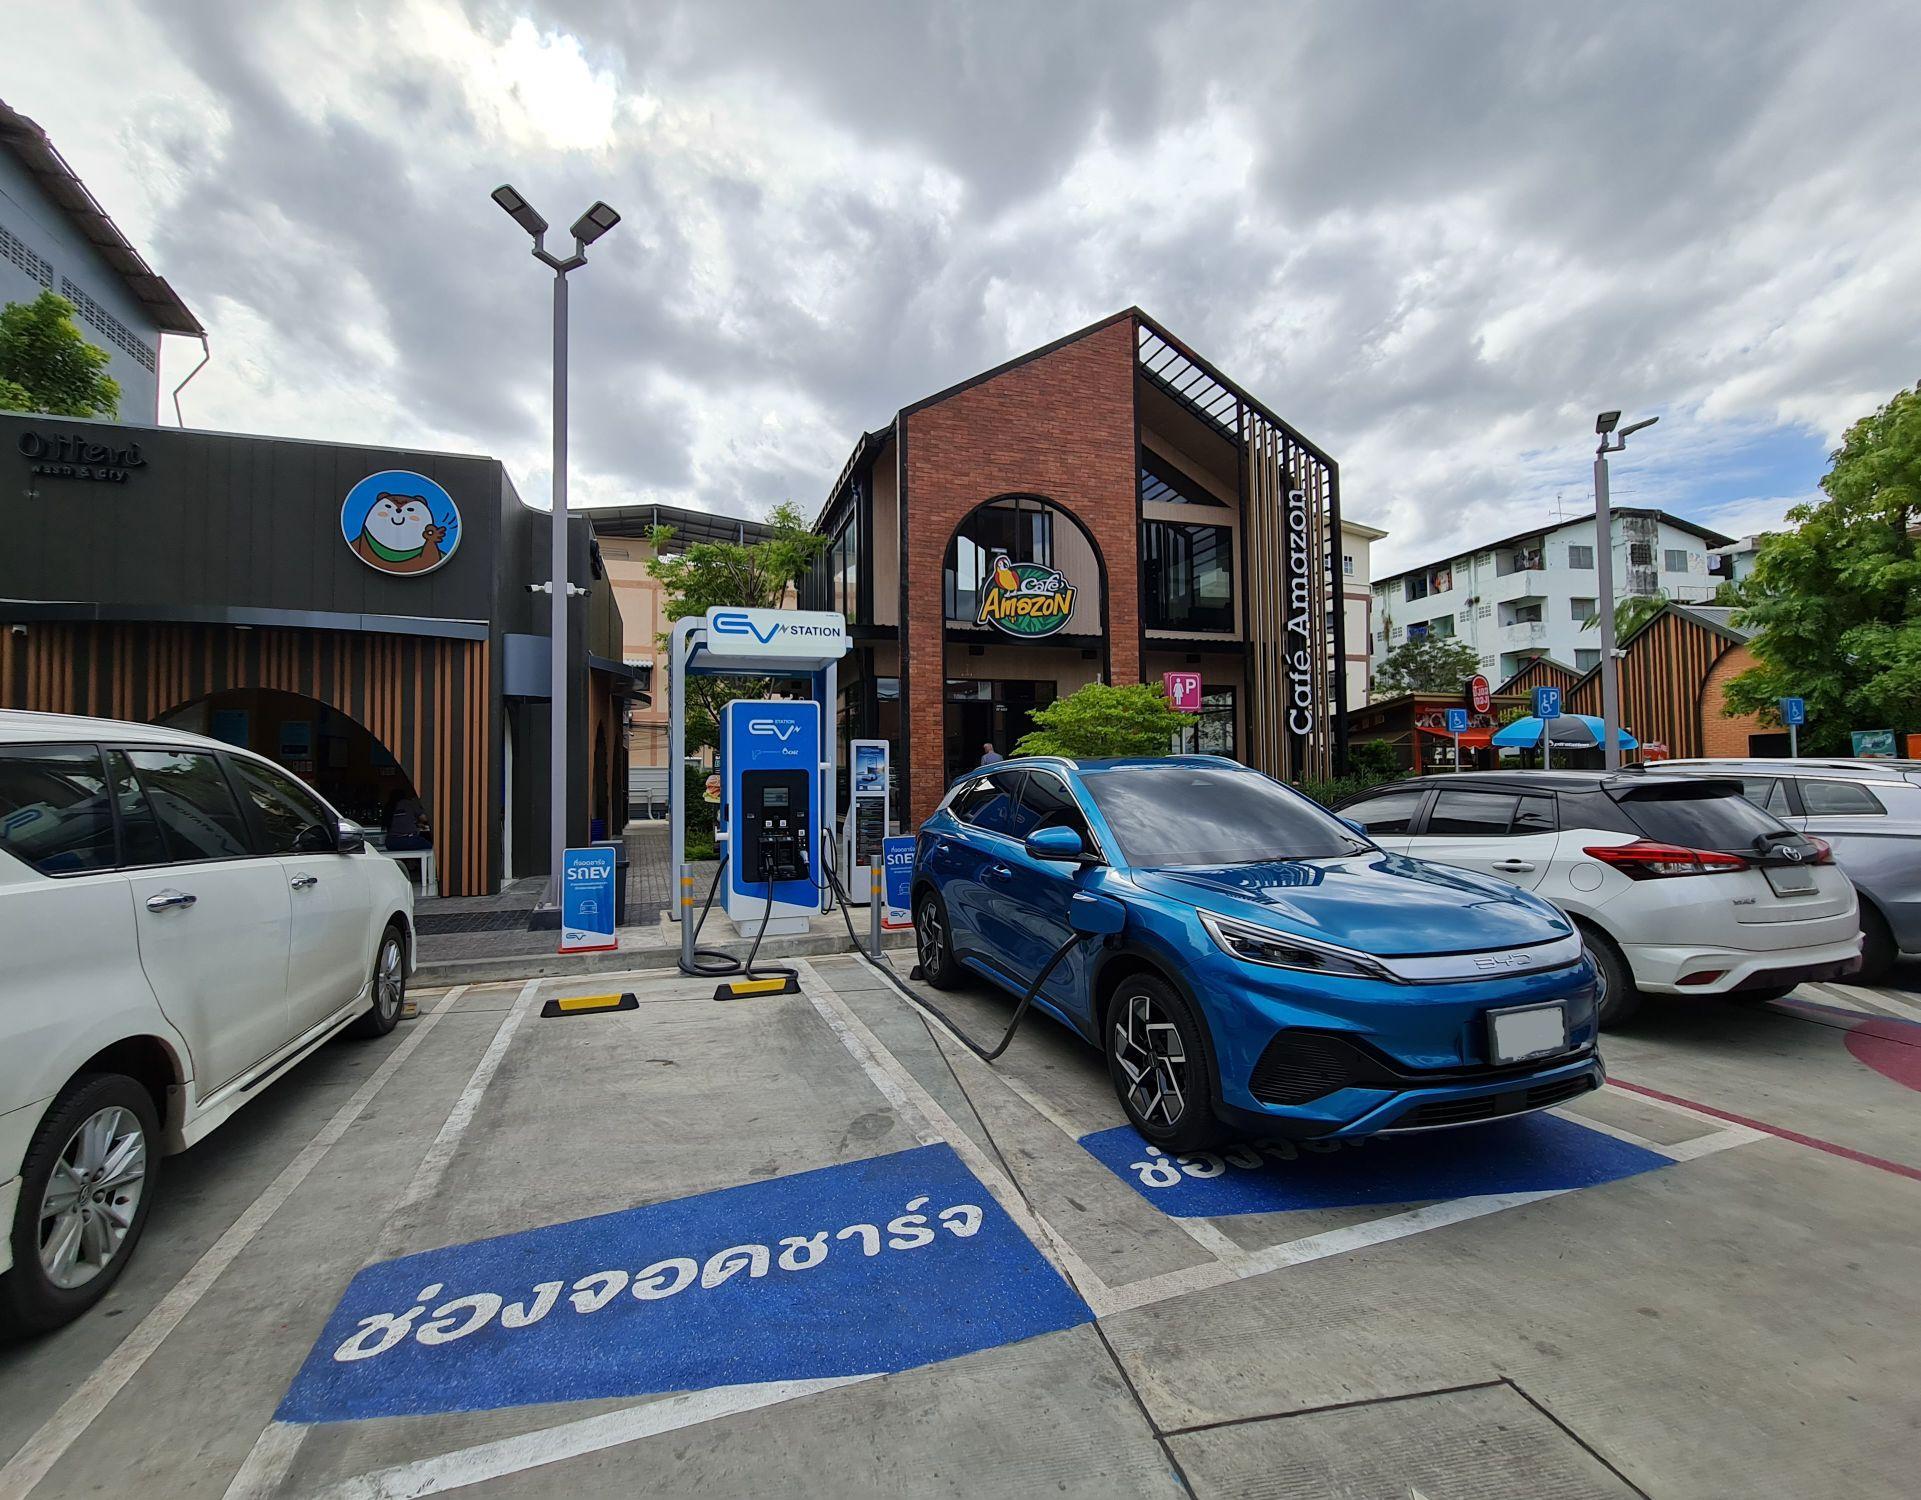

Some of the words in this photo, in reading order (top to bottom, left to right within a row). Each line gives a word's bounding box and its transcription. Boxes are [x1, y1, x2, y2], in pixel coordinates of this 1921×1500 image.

[1288, 488, 1310, 639] Amazon
[790, 625, 841, 637] STATION
[1185, 678, 1197, 694] P
[1285, 650, 1313, 735] Café
[1550, 691, 1557, 704] P
[1473, 954, 1533, 970] BYD
[333, 1196, 985, 1363] ช่องจอดชาร์จ
